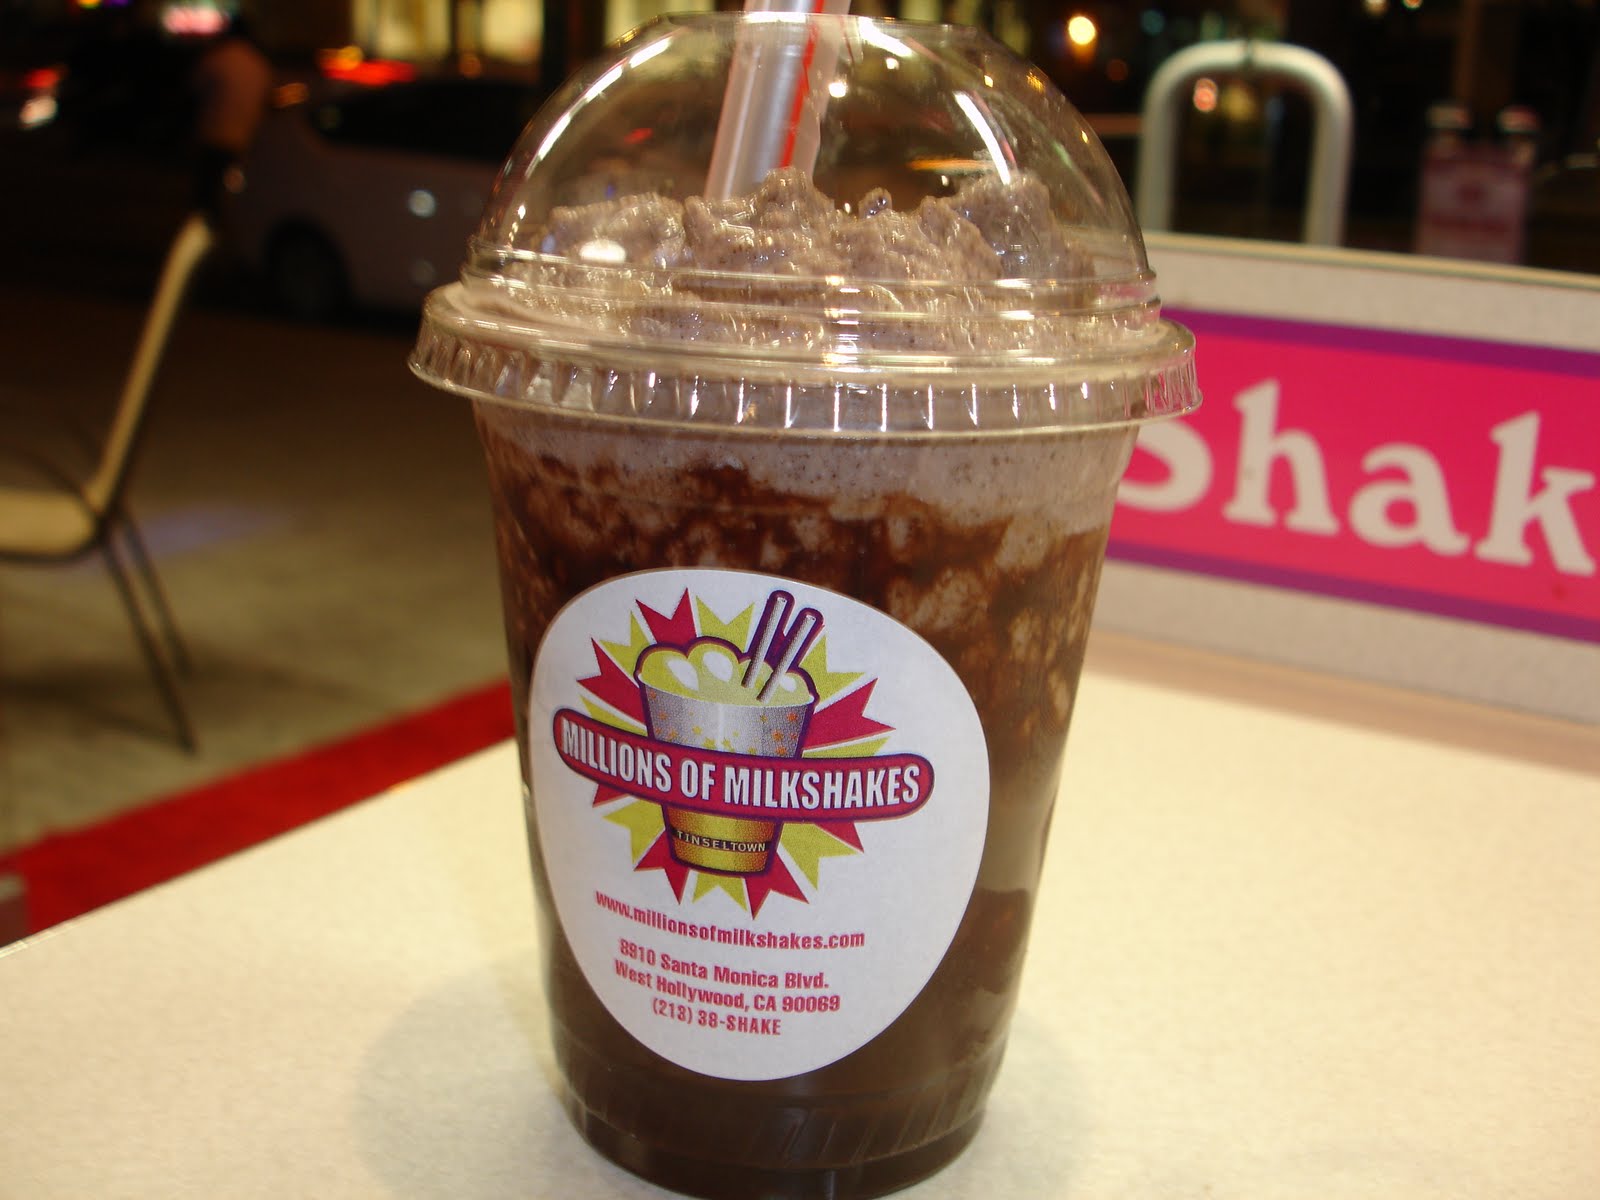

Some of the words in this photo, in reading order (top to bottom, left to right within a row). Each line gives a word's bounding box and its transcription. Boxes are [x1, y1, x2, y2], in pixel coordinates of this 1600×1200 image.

[561, 717, 672, 793] MILLIONS
[680, 760, 715, 800] OF
[724, 765, 920, 810] MILKSHAKES
[676, 830, 767, 852] TINSELTOWN
[595, 891, 865, 950] www.millionsofmilkshakes.com
[614, 959, 652, 988] West
[656, 976, 750, 1012] Hollywood,
[753, 994, 777, 1012] CA
[782, 995, 841, 1013] 90069
[661, 954, 708, 979] Santa
[714, 965, 779, 988] Monica
[785, 972, 829, 989] Blvd.
[652, 997, 693, 1024] (213)
[698, 1010, 782, 1036] 38-SHAKE
